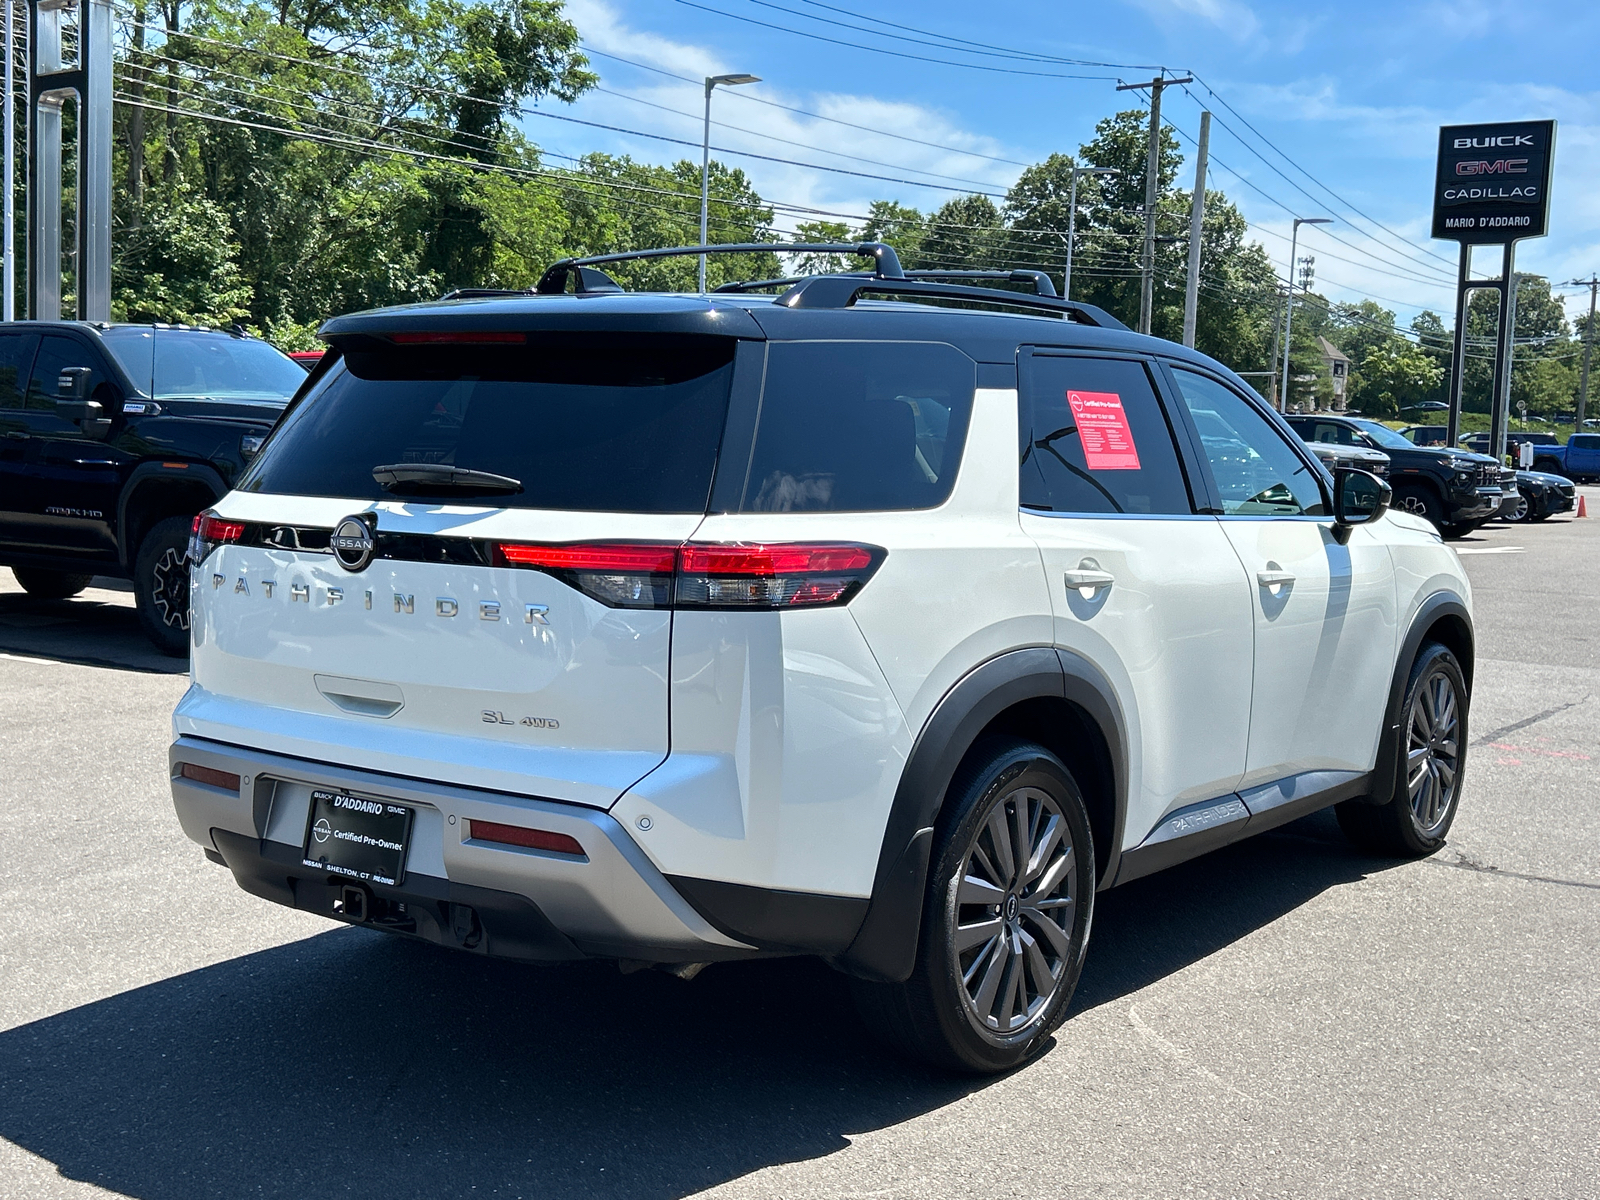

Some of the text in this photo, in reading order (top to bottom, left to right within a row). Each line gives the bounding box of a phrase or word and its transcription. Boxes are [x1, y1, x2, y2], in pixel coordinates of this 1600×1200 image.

[1453, 135, 1534, 149] BUICK
[1455, 159, 1529, 176] GMC
[1443, 186, 1537, 200] CADILLAC
[1445, 216, 1530, 228] MARIO D'ADDARIO
[330, 538, 372, 549] NISSAN
[212, 573, 551, 625] PATHFINDER
[481, 709, 560, 730] SL 4WD
[313, 791, 406, 815] BUICK D'ADDARIO GMC
[1171, 801, 1245, 833] PATHFINDER
[313, 826, 331, 835] NISSAN
[333, 829, 363, 843] Certified
[302, 859, 323, 869] NISSAN
[360, 872, 370, 880] CT
